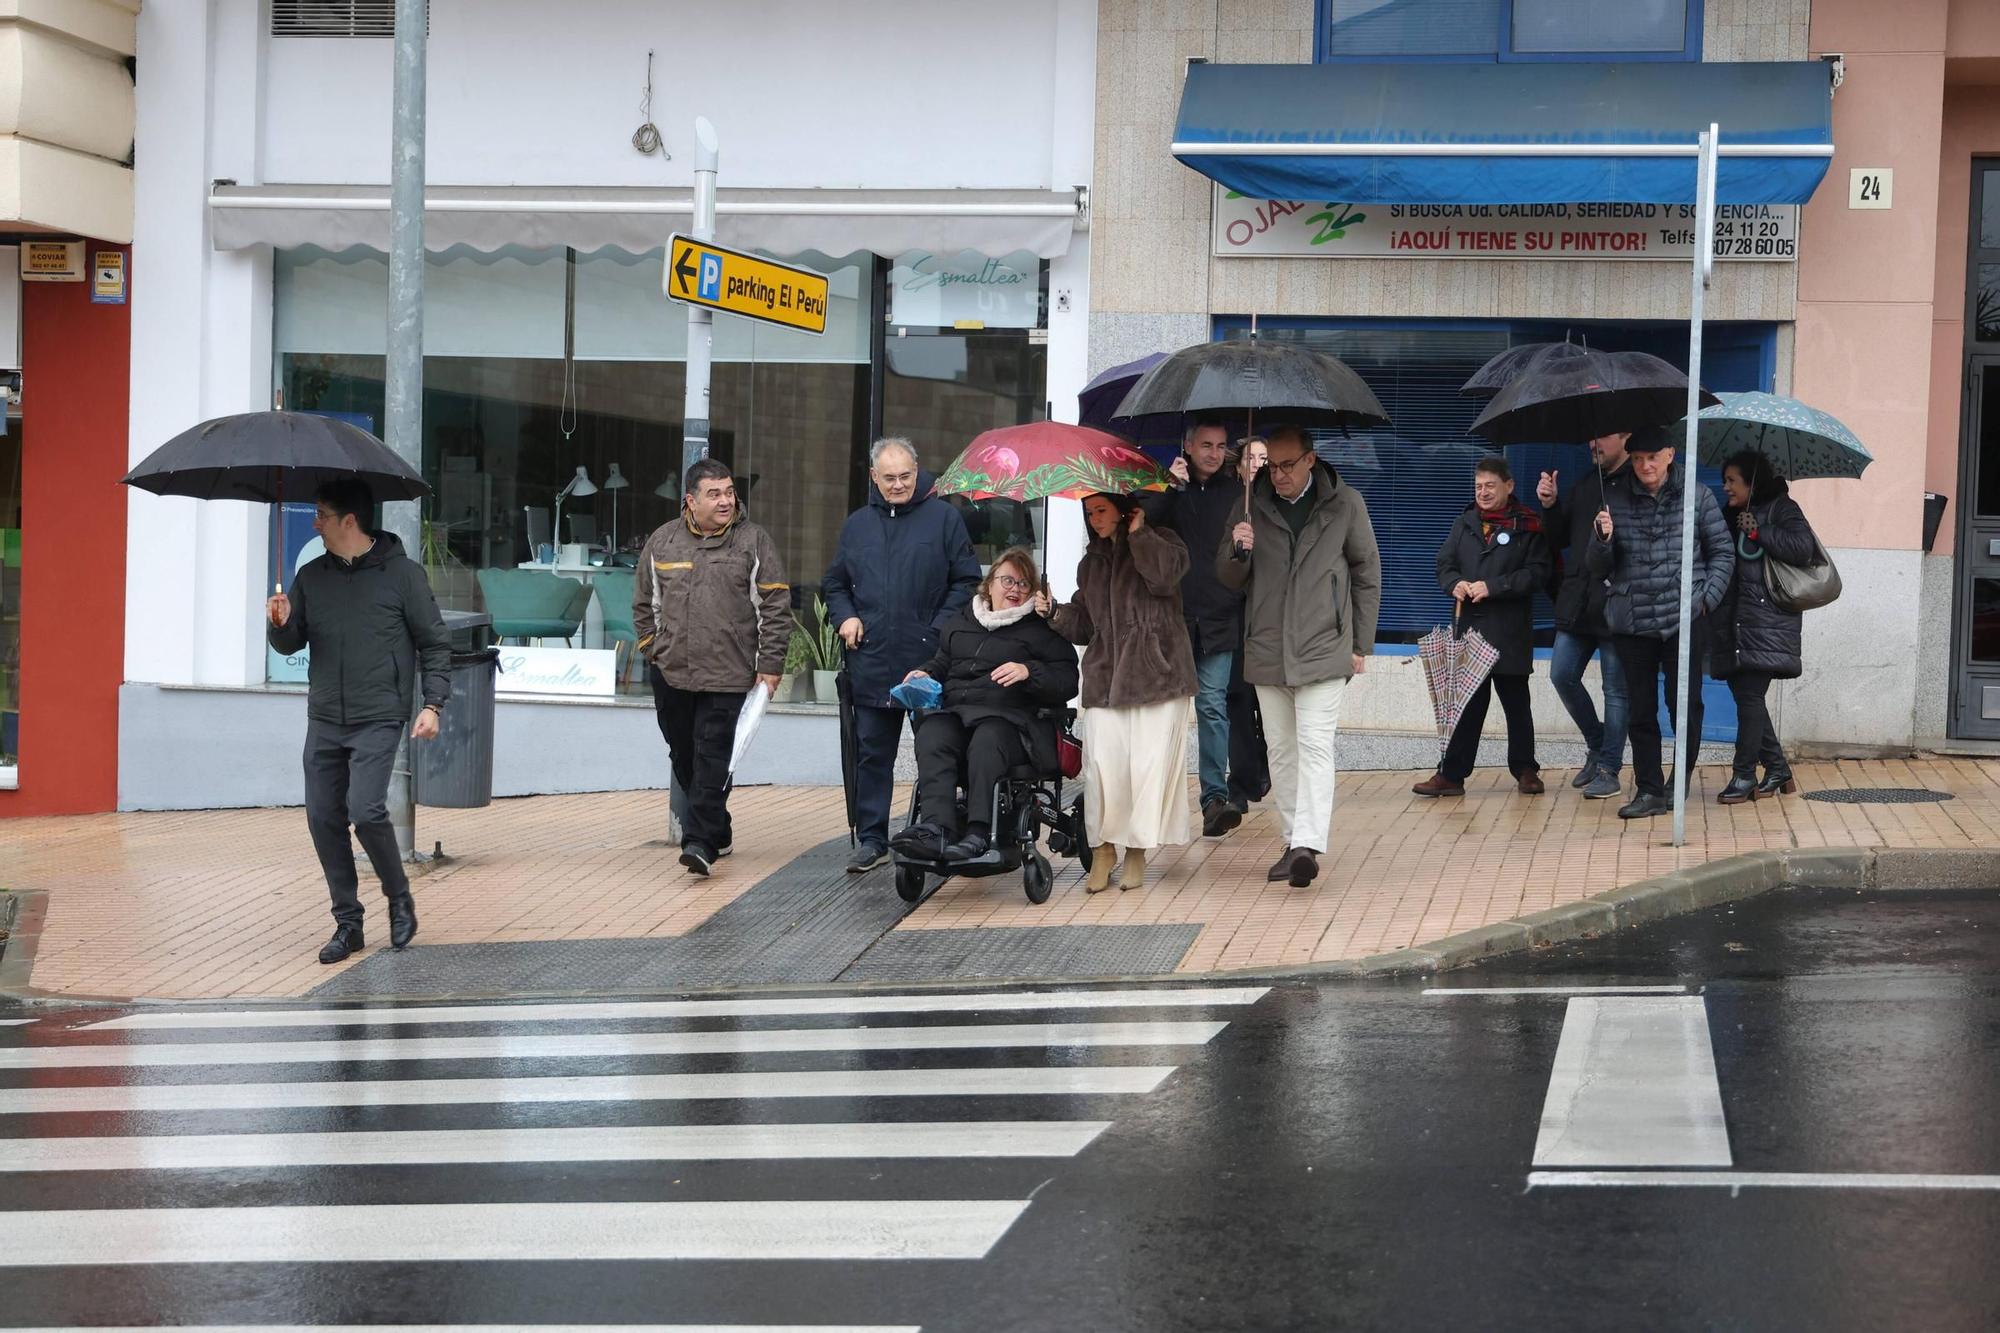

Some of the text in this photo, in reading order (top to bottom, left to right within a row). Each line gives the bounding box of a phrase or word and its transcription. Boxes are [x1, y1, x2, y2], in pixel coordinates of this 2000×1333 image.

[1861, 176, 1880, 200] 24
[1410, 203, 1463, 218] BUSCA
[1468, 203, 1492, 218] Ud.
[1498, 203, 1571, 220] CALIDAD,
[1576, 202, 1656, 218] SERIEDAD
[1663, 203, 1673, 218] Y
[1390, 226, 1450, 250] ¡AQUÍ
[1457, 231, 1517, 250] TIENE
[1524, 231, 1553, 250] SU
[1560, 231, 1647, 251] PINTOR!
[1715, 222, 1779, 236] 24 11 20
[1712, 239, 1793, 256] 07 28 60 05
[902, 255, 1022, 293] Esmaltea
[702, 258, 824, 316] P parking El Perú
